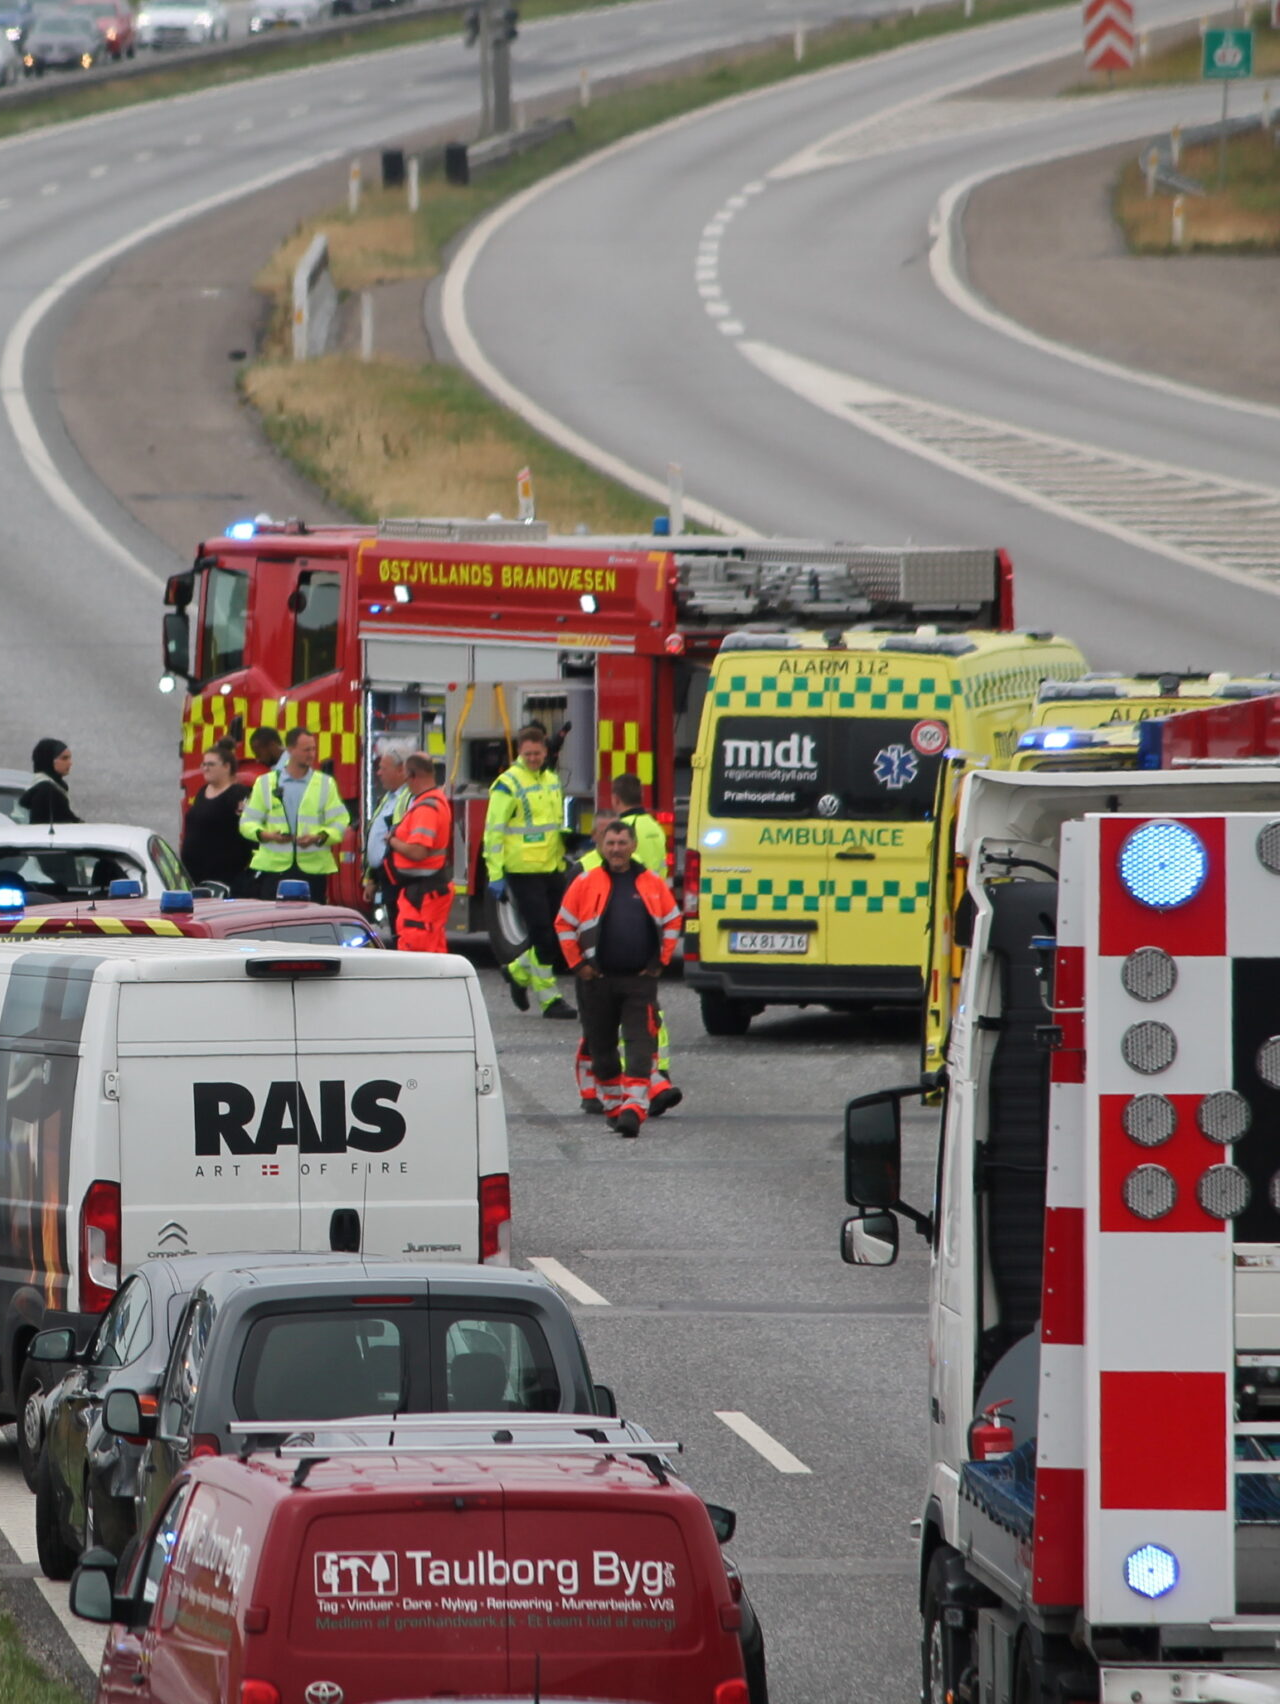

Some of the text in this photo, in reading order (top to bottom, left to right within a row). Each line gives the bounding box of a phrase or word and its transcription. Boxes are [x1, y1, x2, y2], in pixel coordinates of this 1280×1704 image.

[379, 558, 617, 592] ØSTJYLLANDS BRANDVÆSEN
[778, 658, 889, 676] ALARM 112
[723, 732, 818, 769] midt
[724, 768, 818, 783] regionmidtjylland
[723, 790, 796, 804] Præhospitalet
[758, 828, 904, 847] AMBULANCE
[739, 934, 805, 949] CX 81 716
[193, 1080, 407, 1156] RAIS
[195, 1161, 409, 1177] ART OF FIRE
[405, 1550, 664, 1597] Taulborg Byg
[317, 1599, 339, 1614] Tag
[347, 1598, 394, 1612] Vinduer
[441, 1597, 478, 1613] Nybyg
[486, 1597, 553, 1613] Renovering
[561, 1597, 643, 1613] Murerarbejde
[650, 1598, 675, 1611] VVS
[316, 1616, 372, 1630] Medlem
